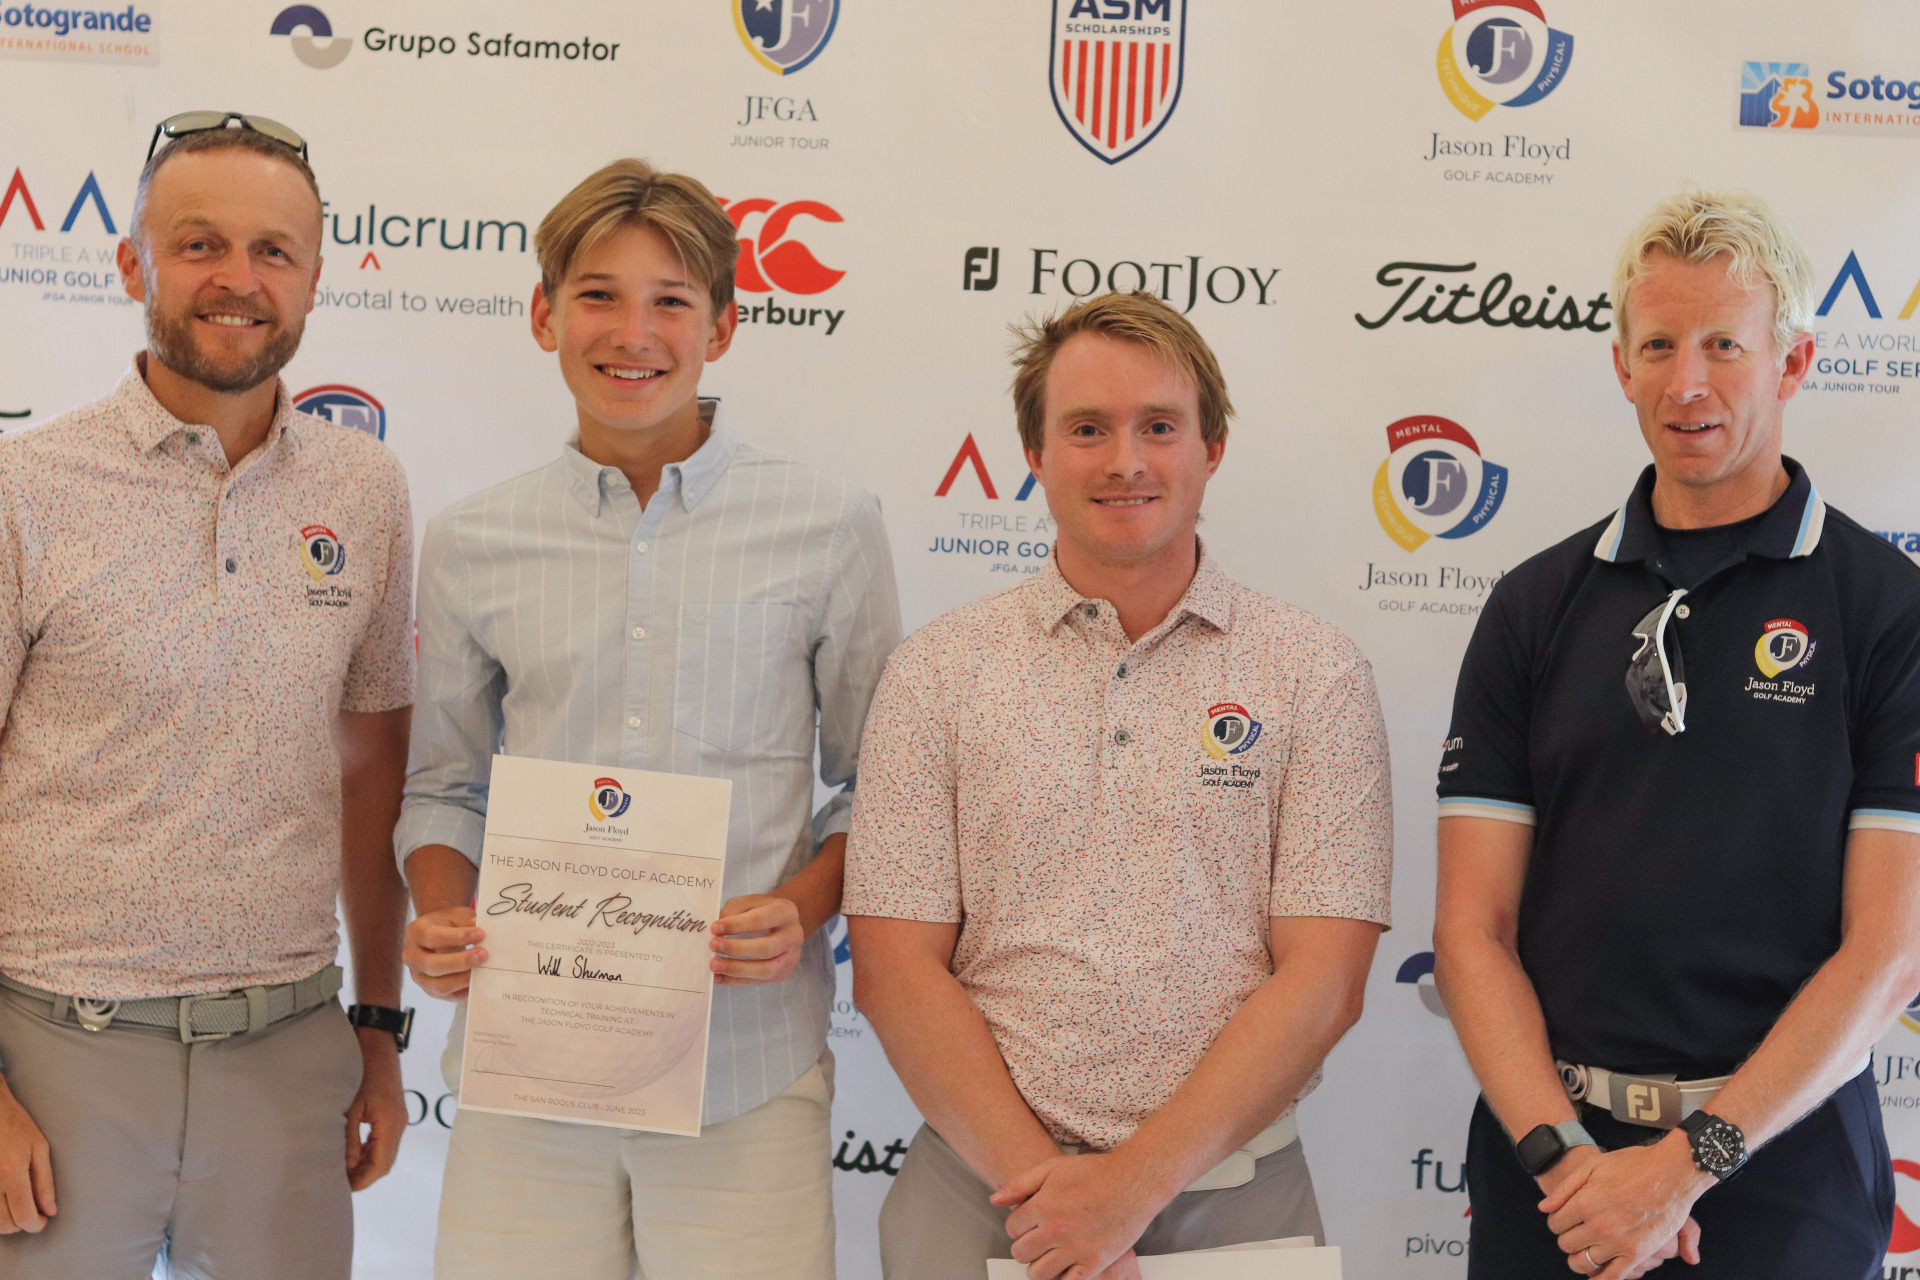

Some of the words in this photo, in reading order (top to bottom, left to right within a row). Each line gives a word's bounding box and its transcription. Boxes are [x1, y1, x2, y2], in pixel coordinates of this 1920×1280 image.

[0, 3, 152, 36] otogrande
[1066, 23, 1171, 36] SCHOLARSHIPS
[99, 43, 150, 56] SCHOOL
[364, 27, 456, 58] Grupo
[467, 32, 620, 61] Safamotor
[1537, 40, 1566, 92] PHYSICAL
[1440, 57, 1481, 113] TECHNIQUE
[737, 95, 818, 126] JFGA
[730, 135, 784, 148] JUNIOR
[789, 137, 830, 150] TOUR
[1424, 132, 1493, 161] Jason
[1503, 135, 1571, 165] Floyd
[1444, 170, 1481, 181] GOLF
[1485, 171, 1554, 184] ACADEMY
[13, 243, 72, 262] TRIPLE
[77, 247, 90, 263] A
[64, 271, 115, 288] GOLF
[69, 294, 104, 303] JUNIOR
[400, 290, 427, 312] to
[436, 295, 524, 317] wealth
[1354, 261, 1613, 333] Titleist
[1834, 333, 1850, 349] A
[1817, 358, 1878, 376] GOLF
[1822, 382, 1865, 393] JUNIOR
[1869, 383, 1900, 394] TOUR
[1395, 424, 1443, 439] MENTAL
[1473, 473, 1500, 525] PHYSICAL
[958, 512, 1028, 532] TRIPLE
[1033, 517, 1049, 533] A
[1377, 489, 1416, 545] TECHNIQUE
[929, 536, 1009, 556] JUNIOR
[990, 563, 1018, 573] JFGA
[1359, 562, 1428, 591] Jason
[1379, 600, 1416, 612] GOLF
[1420, 602, 1484, 615] ACADEM
[1767, 621, 1792, 630] MENTAL
[1744, 676, 1778, 691] Jason
[1782, 680, 1815, 697] Floyd
[1753, 692, 1772, 700] GOLF
[1773, 694, 1807, 704] ACADEMY
[1210, 705, 1238, 715] MENTAL
[1197, 764, 1228, 778] Jason
[1231, 765, 1261, 780] Floyd
[1202, 779, 1221, 787] GOLF
[1223, 780, 1254, 788] ACADEMY
[583, 823, 606, 833] Jason
[608, 825, 629, 837] Floyd
[489, 854, 514, 867] THE
[517, 857, 561, 872] JASON
[564, 862, 608, 877] FLOYD
[611, 867, 647, 881] GOLF
[649, 872, 715, 889] ACADEMY
[486, 882, 589, 921] Student
[587, 892, 708, 935] Recognition
[527, 940, 544, 949] THIS
[545, 942, 594, 955] CERTIFICATE
[604, 949, 650, 960] PRESENTED
[651, 954, 664, 963] TO:
[537, 952, 562, 977] Will
[572, 954, 623, 982] Sherman
[512, 994, 566, 1006] RECOGNITION
[581, 1002, 603, 1010] YOUR
[604, 1004, 665, 1018] ACHIEVEMENTS
[541, 1007, 584, 1019] TECHNICAL
[586, 1012, 623, 1024] TRAINING
[520, 1015, 536, 1024] THE
[537, 1017, 563, 1027] JASON
[565, 1020, 591, 1031] FLOYD
[592, 1024, 614, 1033] GOLF
[615, 1027, 654, 1038] ACADEMY
[514, 1093, 529, 1102] THE
[530, 1095, 546, 1104] SAN
[547, 1097, 577, 1108] ROQUE
[577, 1101, 599, 1110] CLUB
[605, 1104, 626, 1113] JUNE
[627, 1107, 646, 1116] 2023
[1406, 1232, 1470, 1258] pivo
